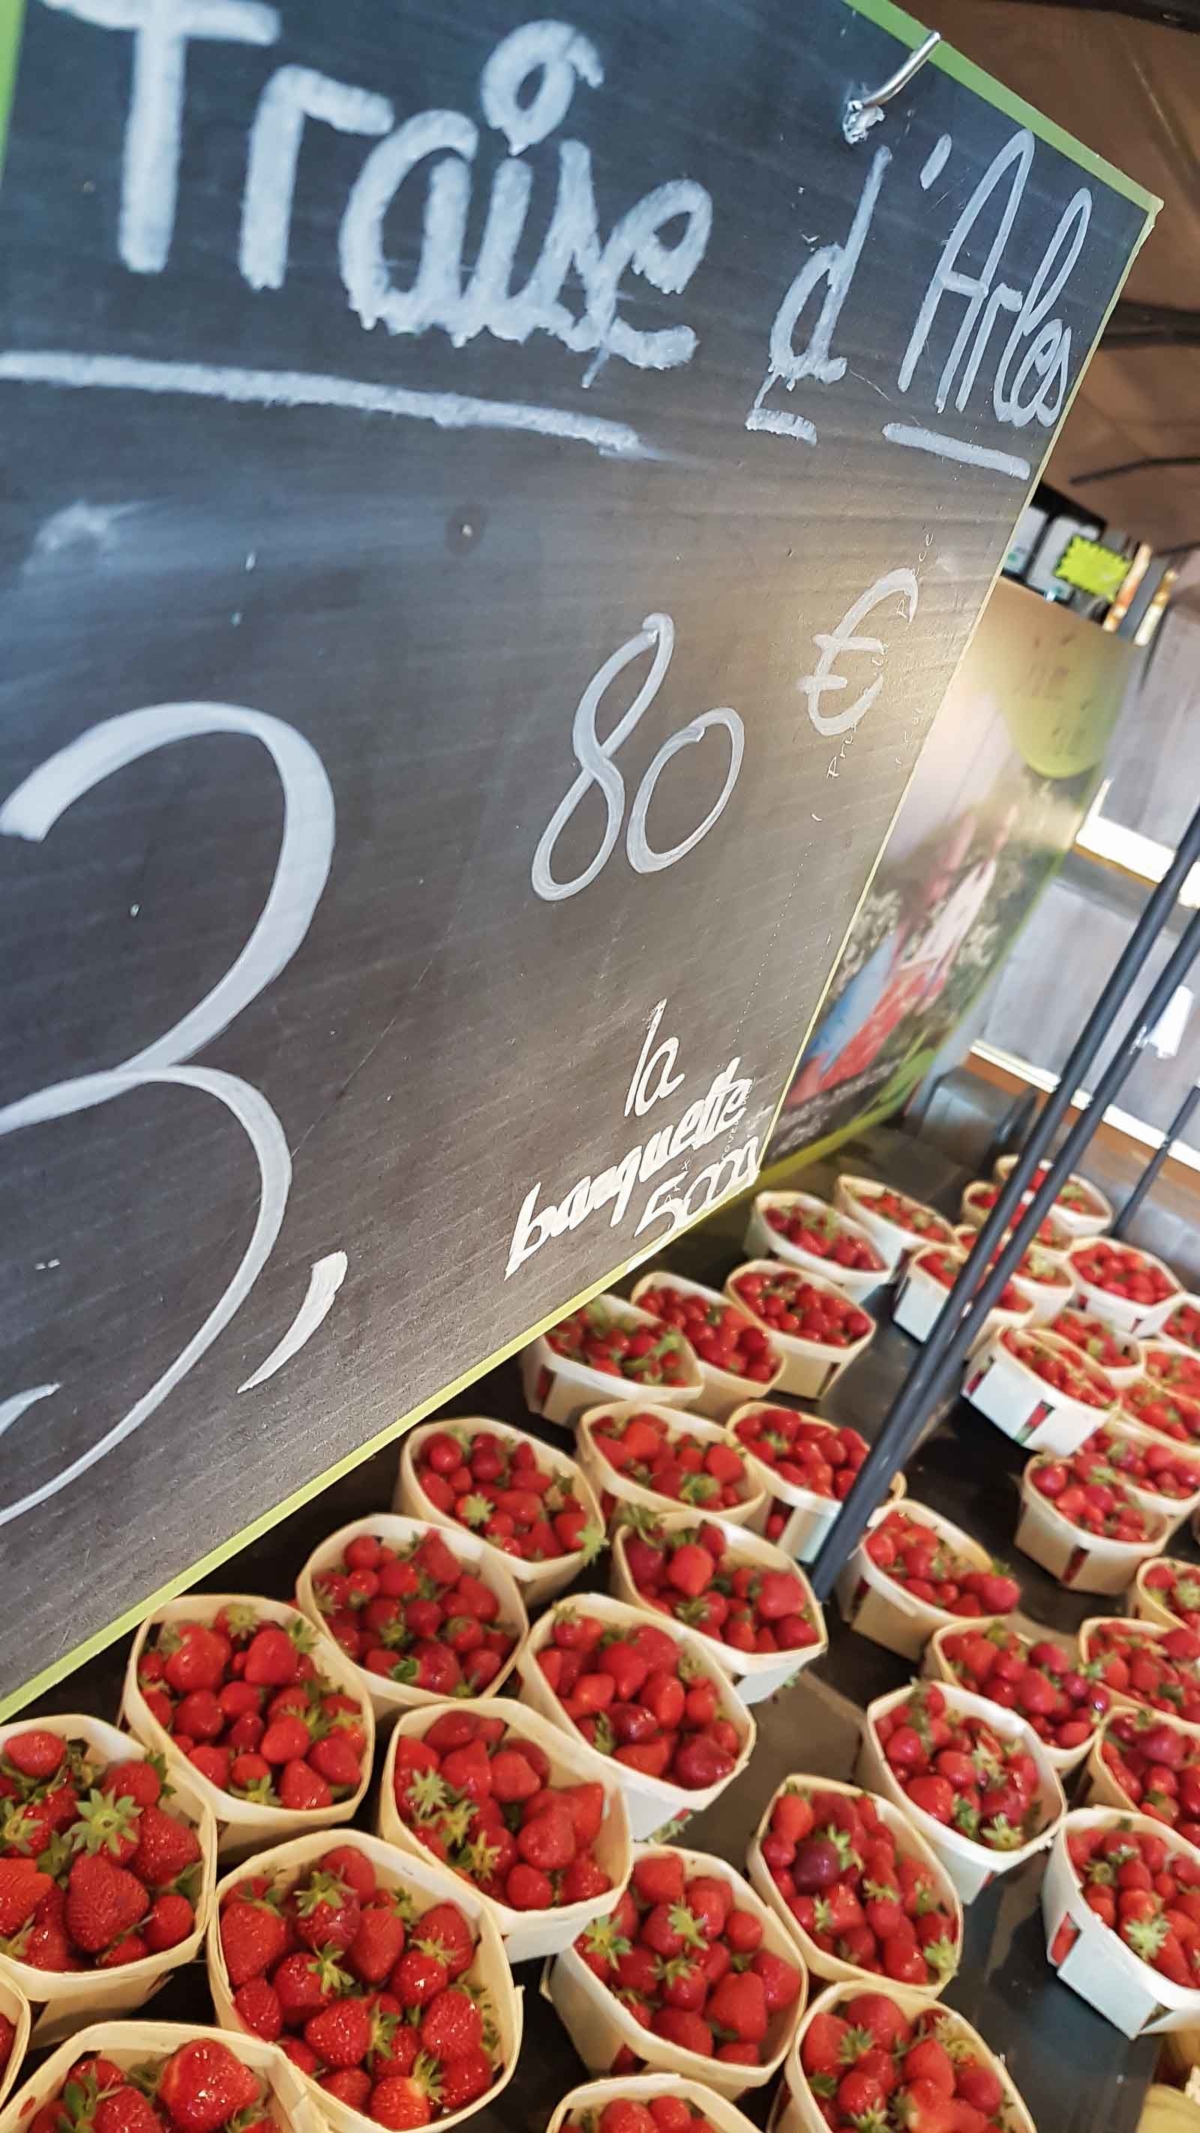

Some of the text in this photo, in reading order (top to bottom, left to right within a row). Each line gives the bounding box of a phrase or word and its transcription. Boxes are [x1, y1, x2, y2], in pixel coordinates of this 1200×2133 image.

[768, 128, 1093, 428] d'Arles
[797, 567, 919, 736] €
[623, 997, 686, 1118] la
